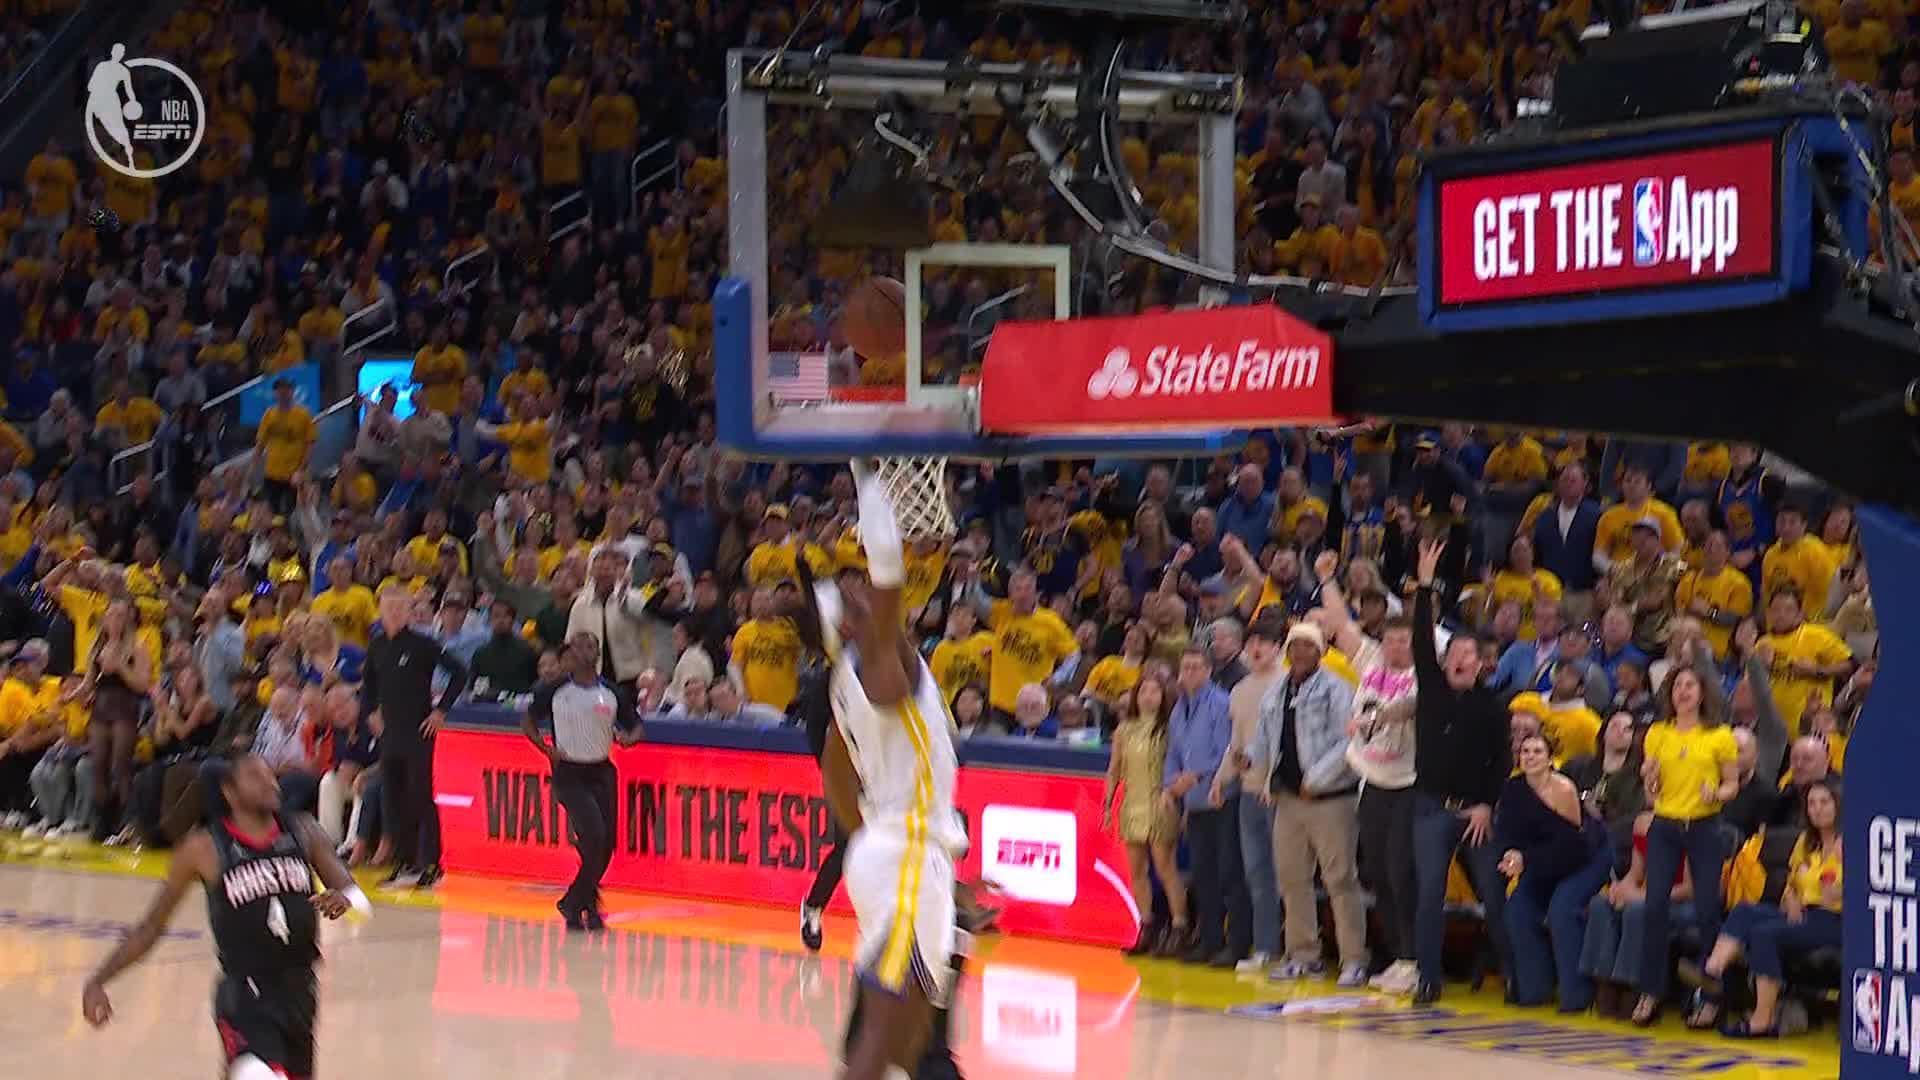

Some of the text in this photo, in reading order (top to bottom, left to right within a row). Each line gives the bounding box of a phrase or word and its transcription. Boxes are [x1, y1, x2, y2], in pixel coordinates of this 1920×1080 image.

[1473, 175, 1739, 280] GET THE App
[481, 769, 838, 870] WAT IN THE ESP
[996, 838, 1061, 869] ESPN
[1868, 815, 1920, 894] GE
[1868, 891, 1919, 973] TH
